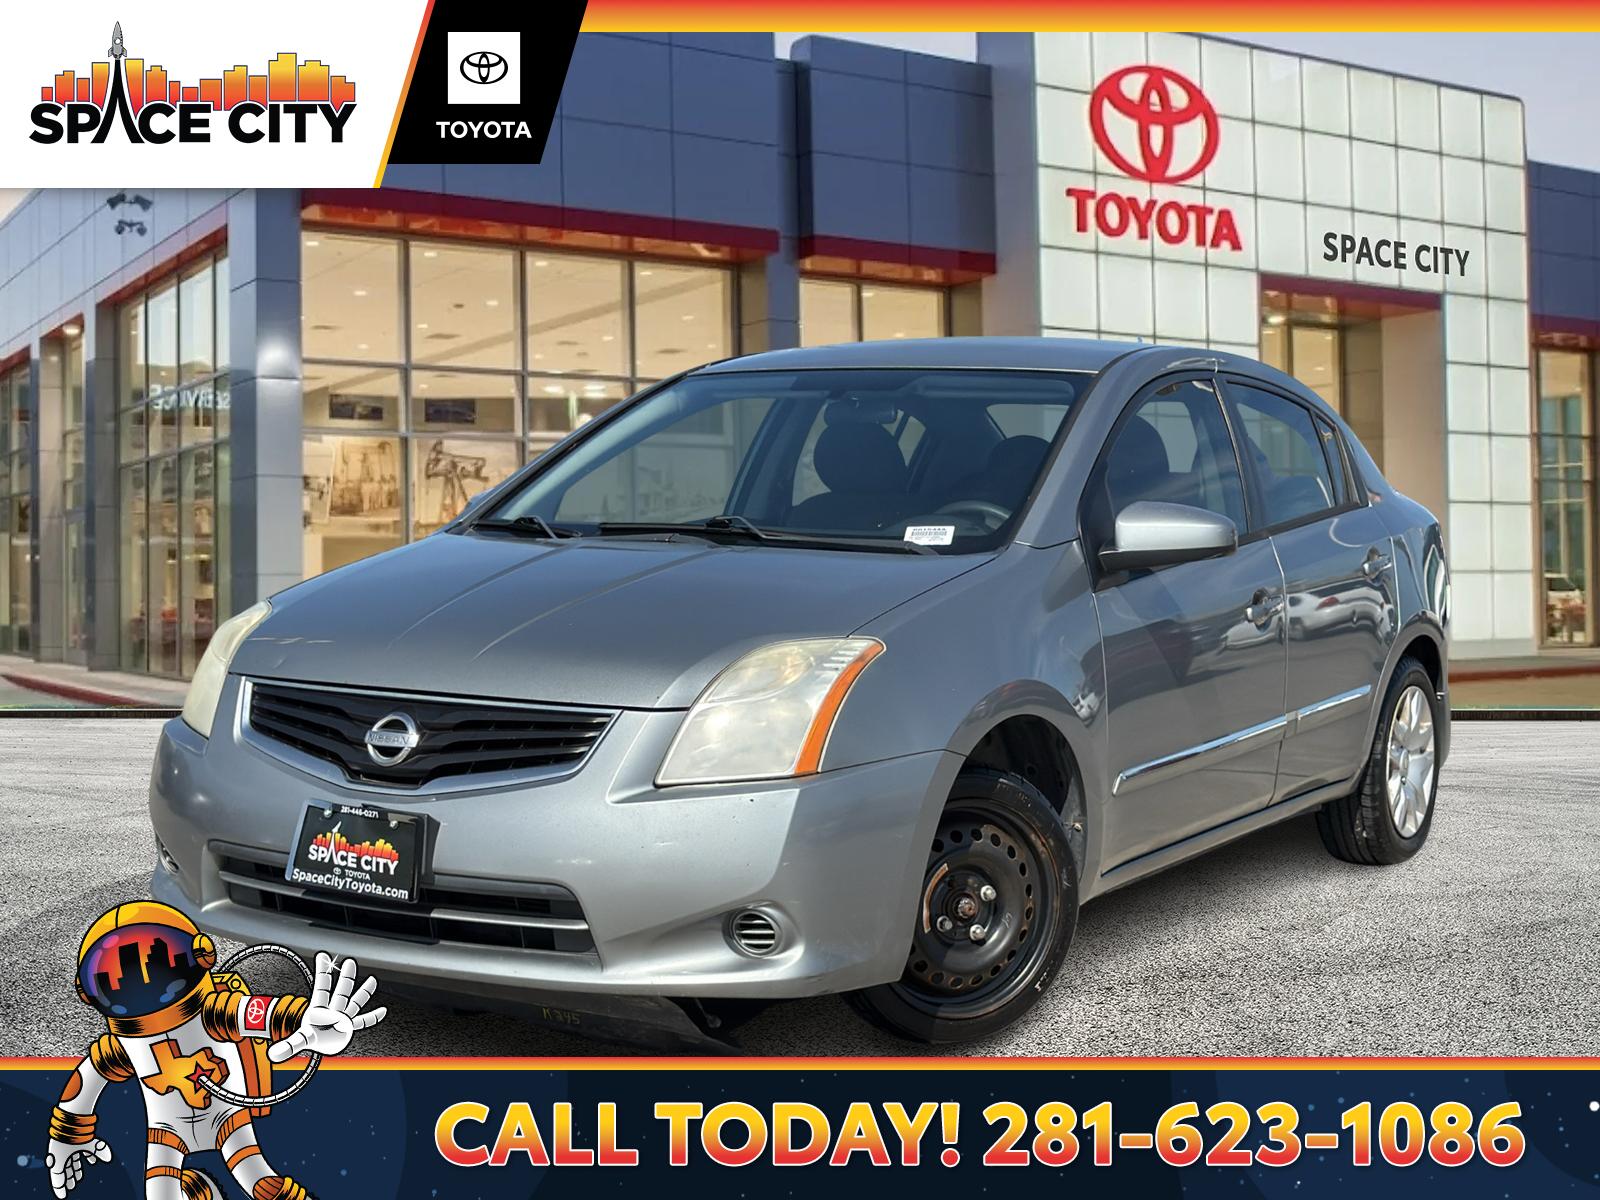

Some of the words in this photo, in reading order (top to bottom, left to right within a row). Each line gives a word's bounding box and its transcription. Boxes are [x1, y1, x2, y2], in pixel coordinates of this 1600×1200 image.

[1066, 188, 1242, 251] TOYOTA
[1323, 232, 1407, 270] SPACE
[1414, 244, 1470, 276] CITY
[368, 732, 410, 745] NISSAN
[308, 844, 357, 868] SPACE
[361, 855, 399, 875] CITY
[345, 869, 371, 881] TOYOTA
[292, 868, 409, 900] SpaceCityToyota.com
